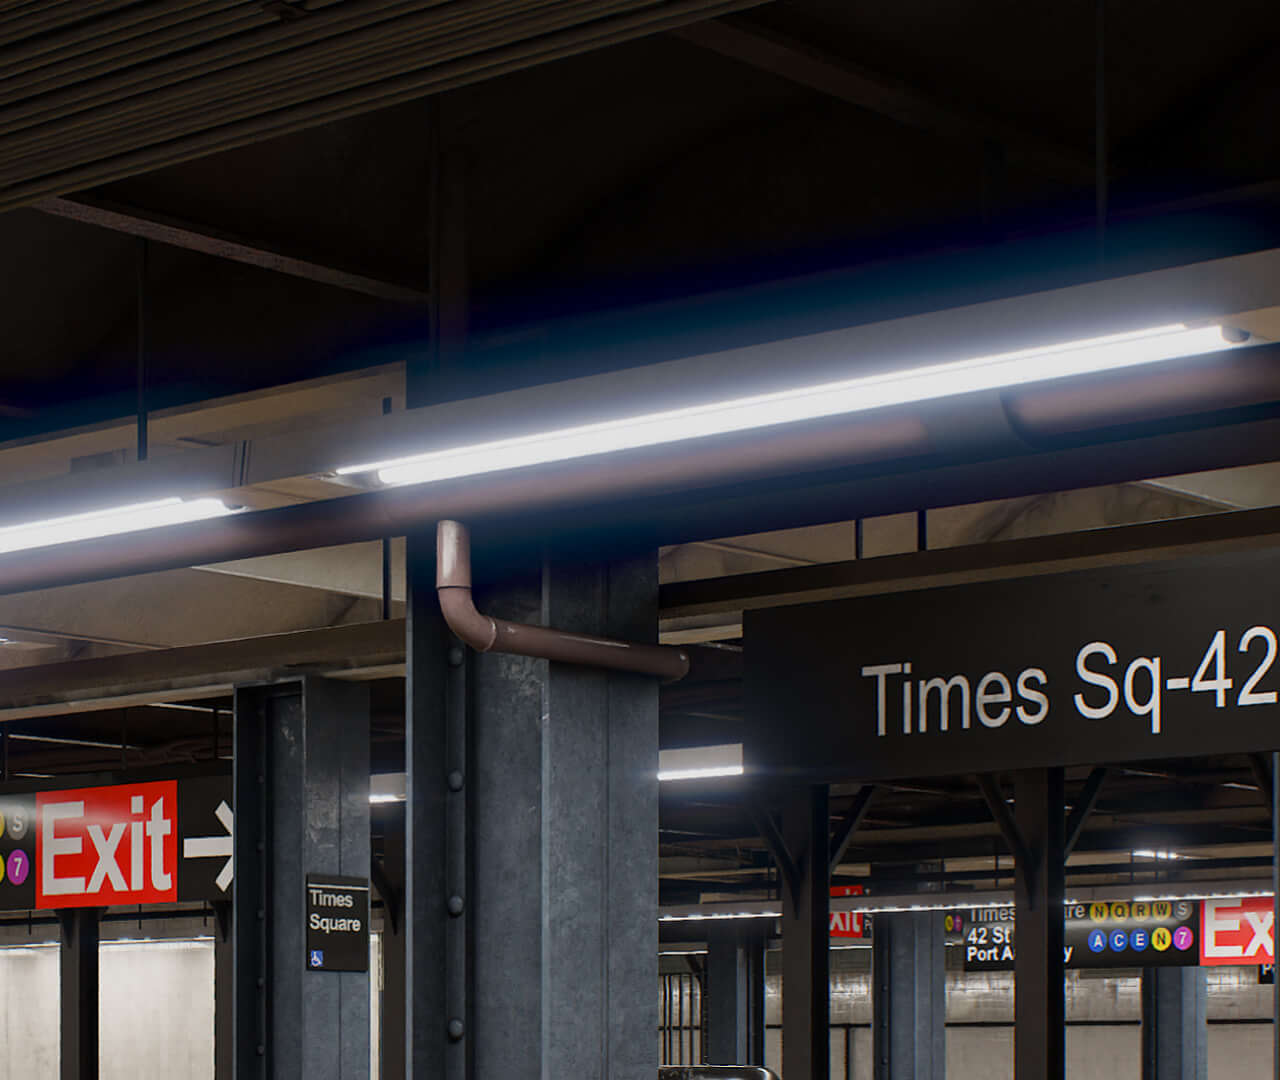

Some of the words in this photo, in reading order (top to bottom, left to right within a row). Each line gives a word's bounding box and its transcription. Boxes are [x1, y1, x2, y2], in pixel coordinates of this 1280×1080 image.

[862, 662, 1049, 736] Times
[1073, 626, 1278, 734] Sq-42
[42, 795, 172, 896] Exit
[309, 889, 354, 908] Times
[309, 913, 361, 934] Square
[967, 927, 988, 944] 42
[992, 926, 1010, 944] St
[967, 946, 999, 961] Port
